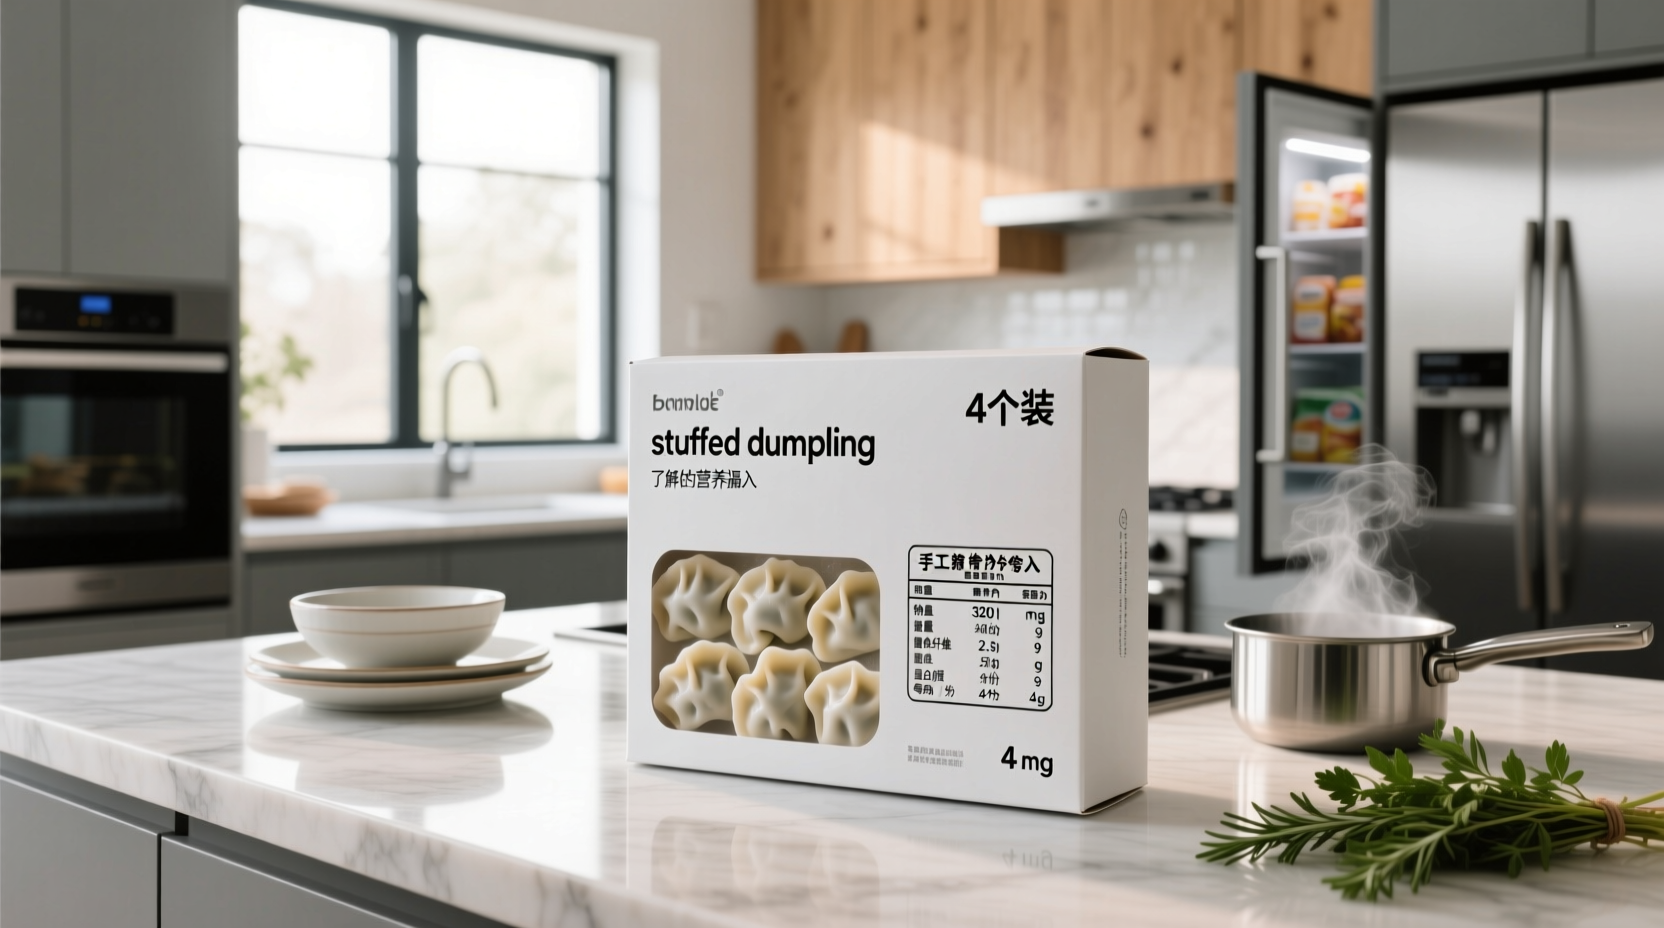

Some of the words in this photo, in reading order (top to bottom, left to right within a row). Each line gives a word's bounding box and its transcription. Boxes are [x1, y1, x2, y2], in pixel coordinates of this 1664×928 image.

[965, 388, 1055, 427] 4个装
[651, 426, 740, 456] stuffed
[747, 426, 875, 466] dumpling
[1000, 745, 1018, 770] 4
[1021, 754, 1054, 778] mg
